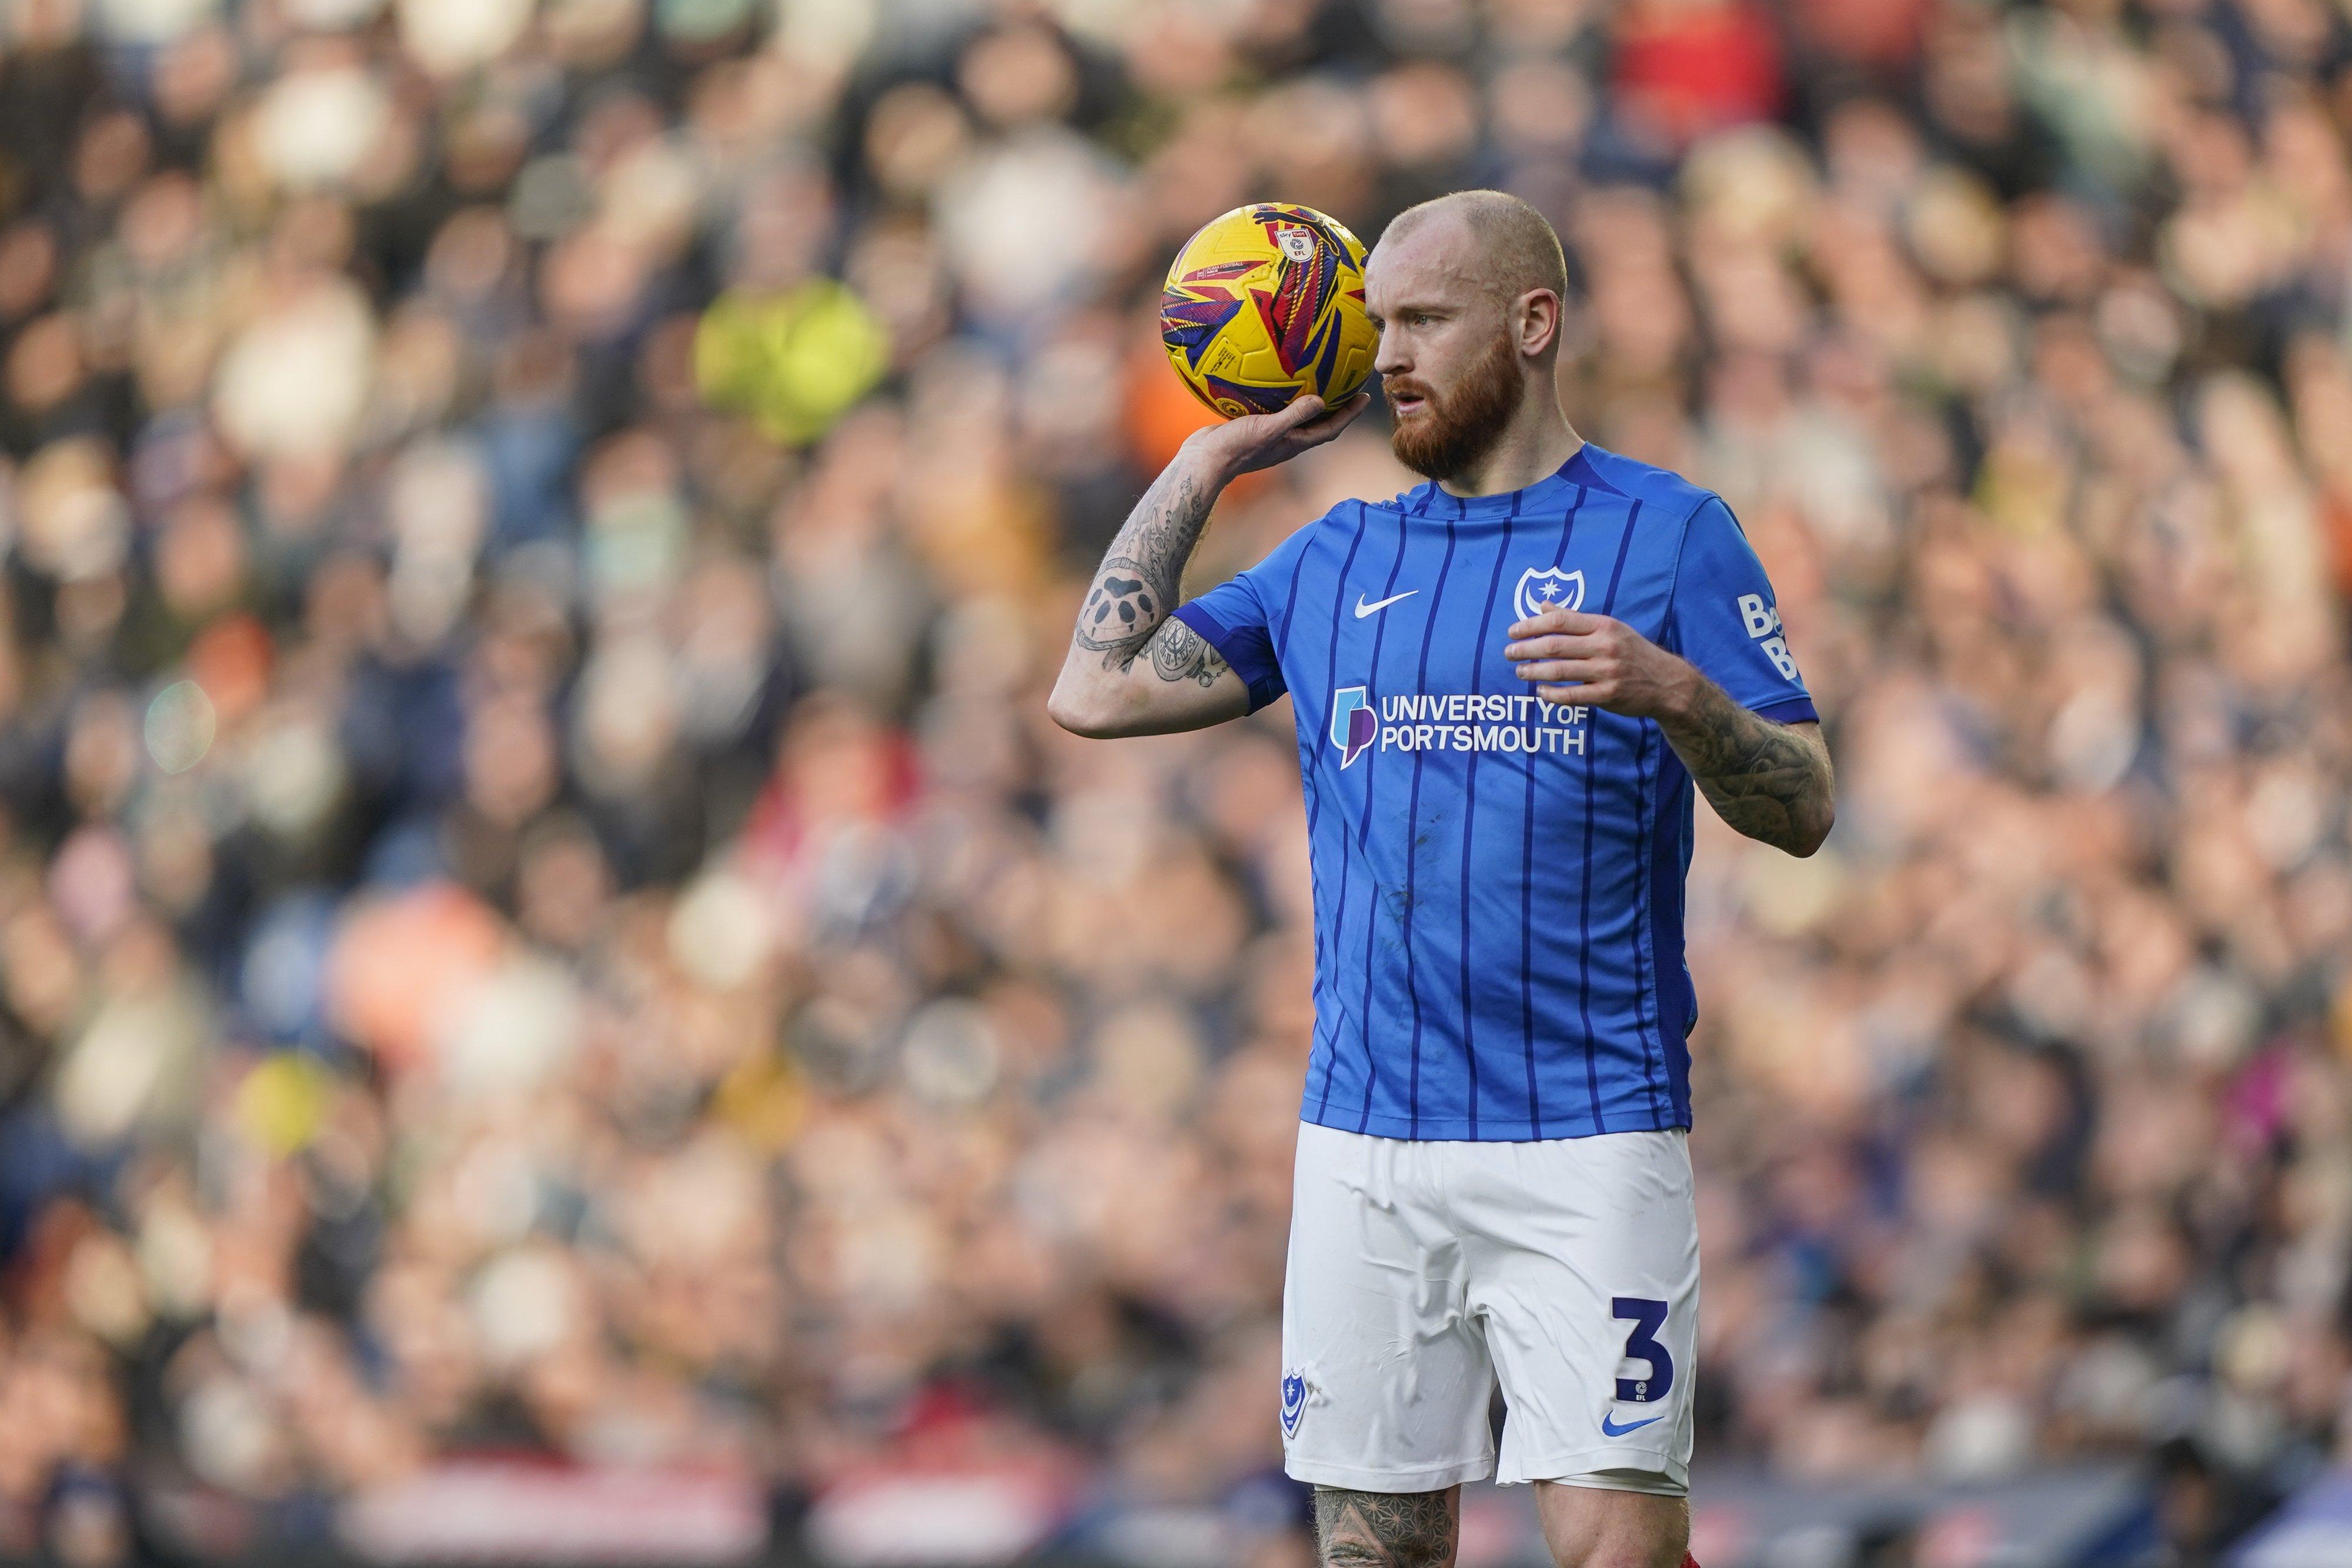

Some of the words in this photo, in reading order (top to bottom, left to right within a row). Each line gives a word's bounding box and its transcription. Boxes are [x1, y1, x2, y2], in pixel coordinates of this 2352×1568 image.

[1382, 694, 1555, 723] UNIVERSITY
[1557, 705, 1589, 724] OF
[1381, 725, 1585, 755] PORTSMOUTH
[1612, 1297, 1673, 1402] 3
